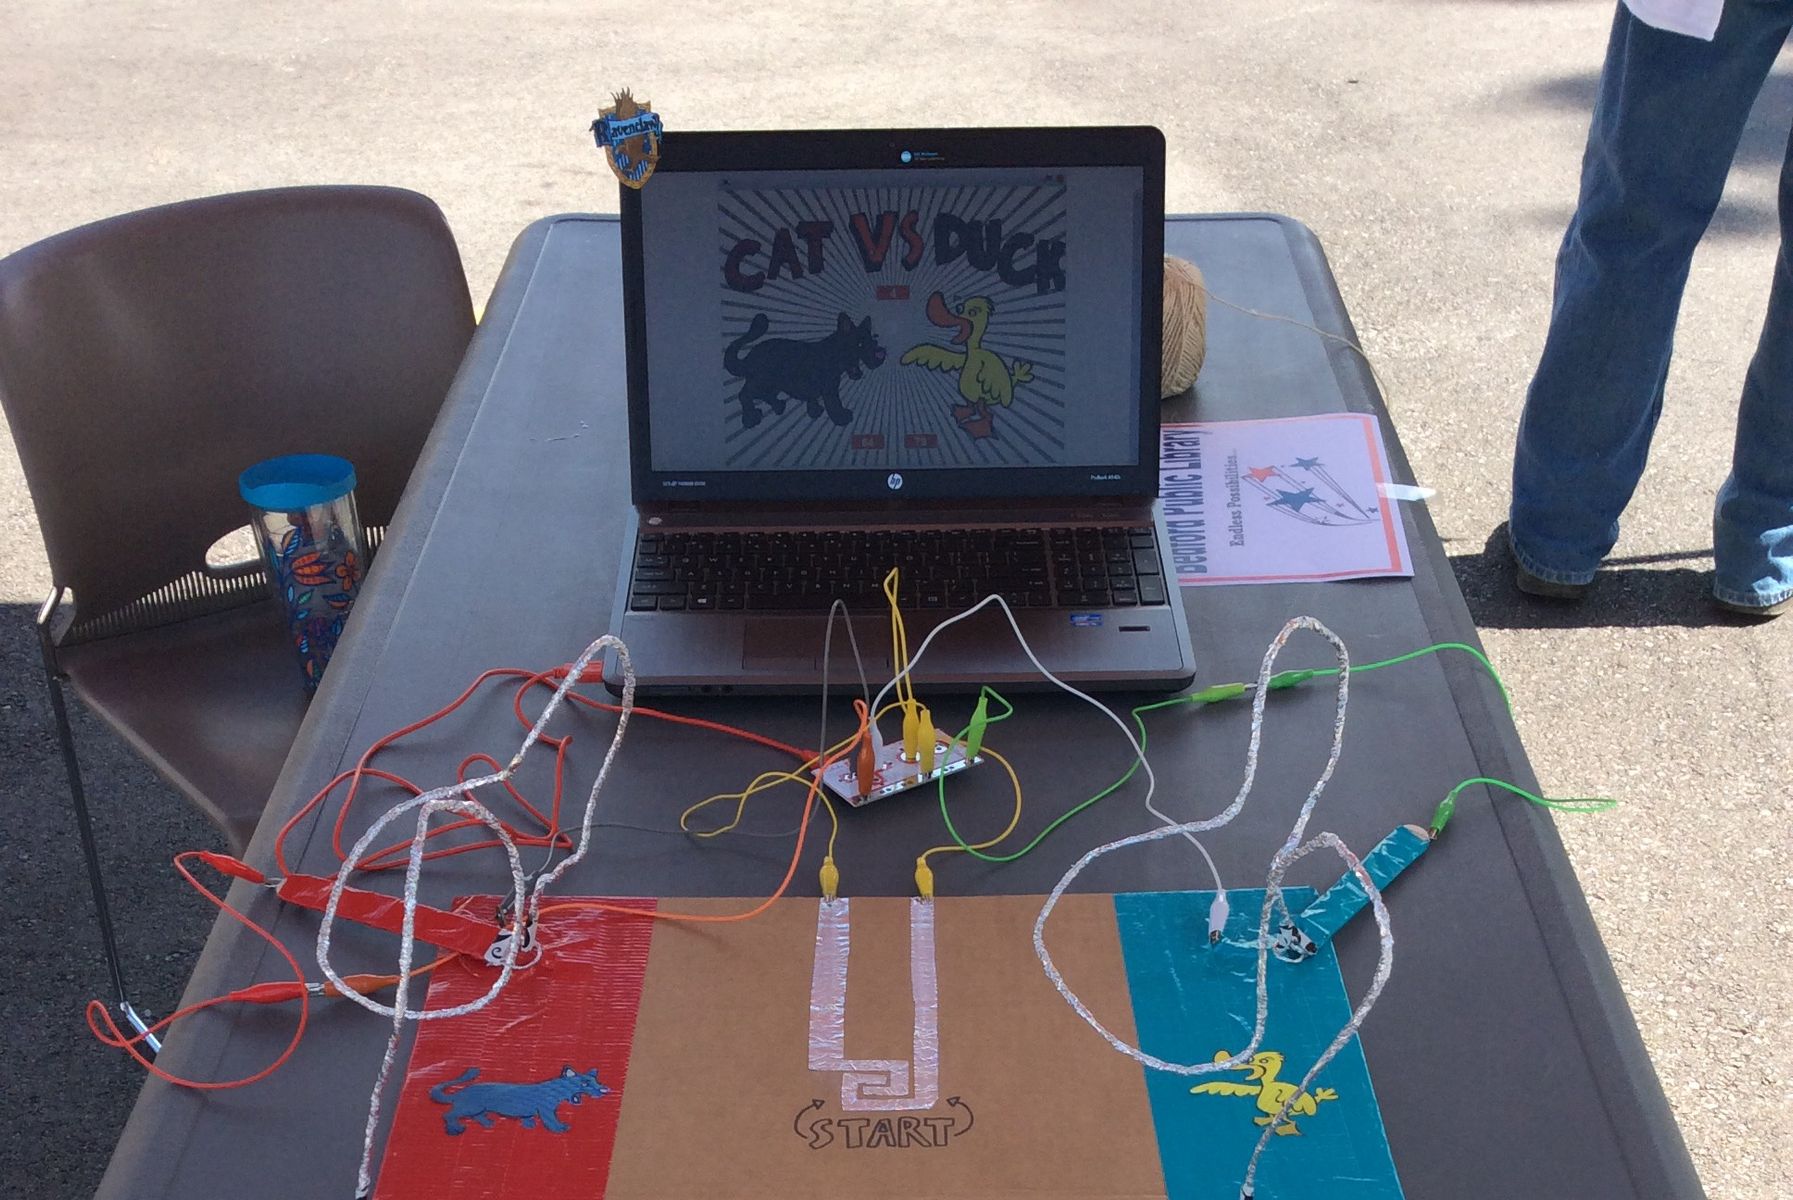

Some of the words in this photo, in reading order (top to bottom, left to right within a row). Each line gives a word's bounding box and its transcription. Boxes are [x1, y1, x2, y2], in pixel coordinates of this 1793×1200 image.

[724, 221, 834, 292] CAT
[850, 209, 924, 273] VS
[934, 212, 1066, 294] DUCK
[1159, 430, 1213, 470] Library
[1159, 474, 1204, 516] Public
[1228, 510, 1244, 548] Endless
[808, 1116, 955, 1150] START
